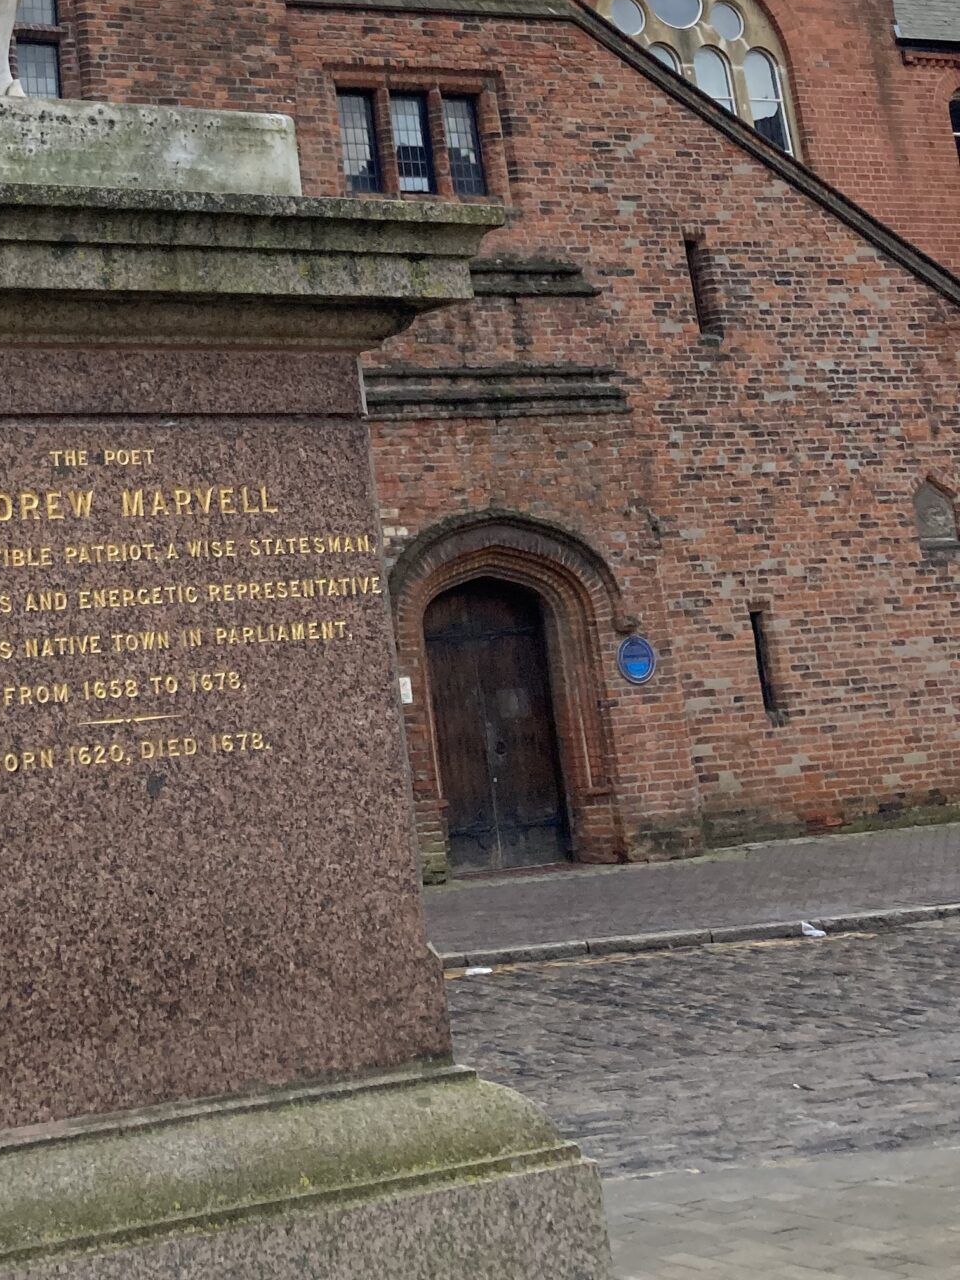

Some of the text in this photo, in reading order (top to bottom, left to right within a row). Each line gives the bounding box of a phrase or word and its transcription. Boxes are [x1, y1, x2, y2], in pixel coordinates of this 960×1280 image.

[49, 448, 155, 467] THE POET
[121, 486, 278, 517] MARVELL
[166, 542, 180, 559] A
[186, 539, 236, 558] WISE
[25, 591, 68, 612] AND
[78, 585, 199, 609] ENERGETIC
[208, 576, 382, 602] REPRESENTATIVE
[24, 635, 101, 658] NATIVE
[112, 631, 170, 652] TOWN
[182, 629, 202, 648] IN
[3, 686, 70, 706] FROM
[83, 678, 138, 700] 1658
[150, 676, 178, 694] TO
[141, 737, 197, 759] DIED
